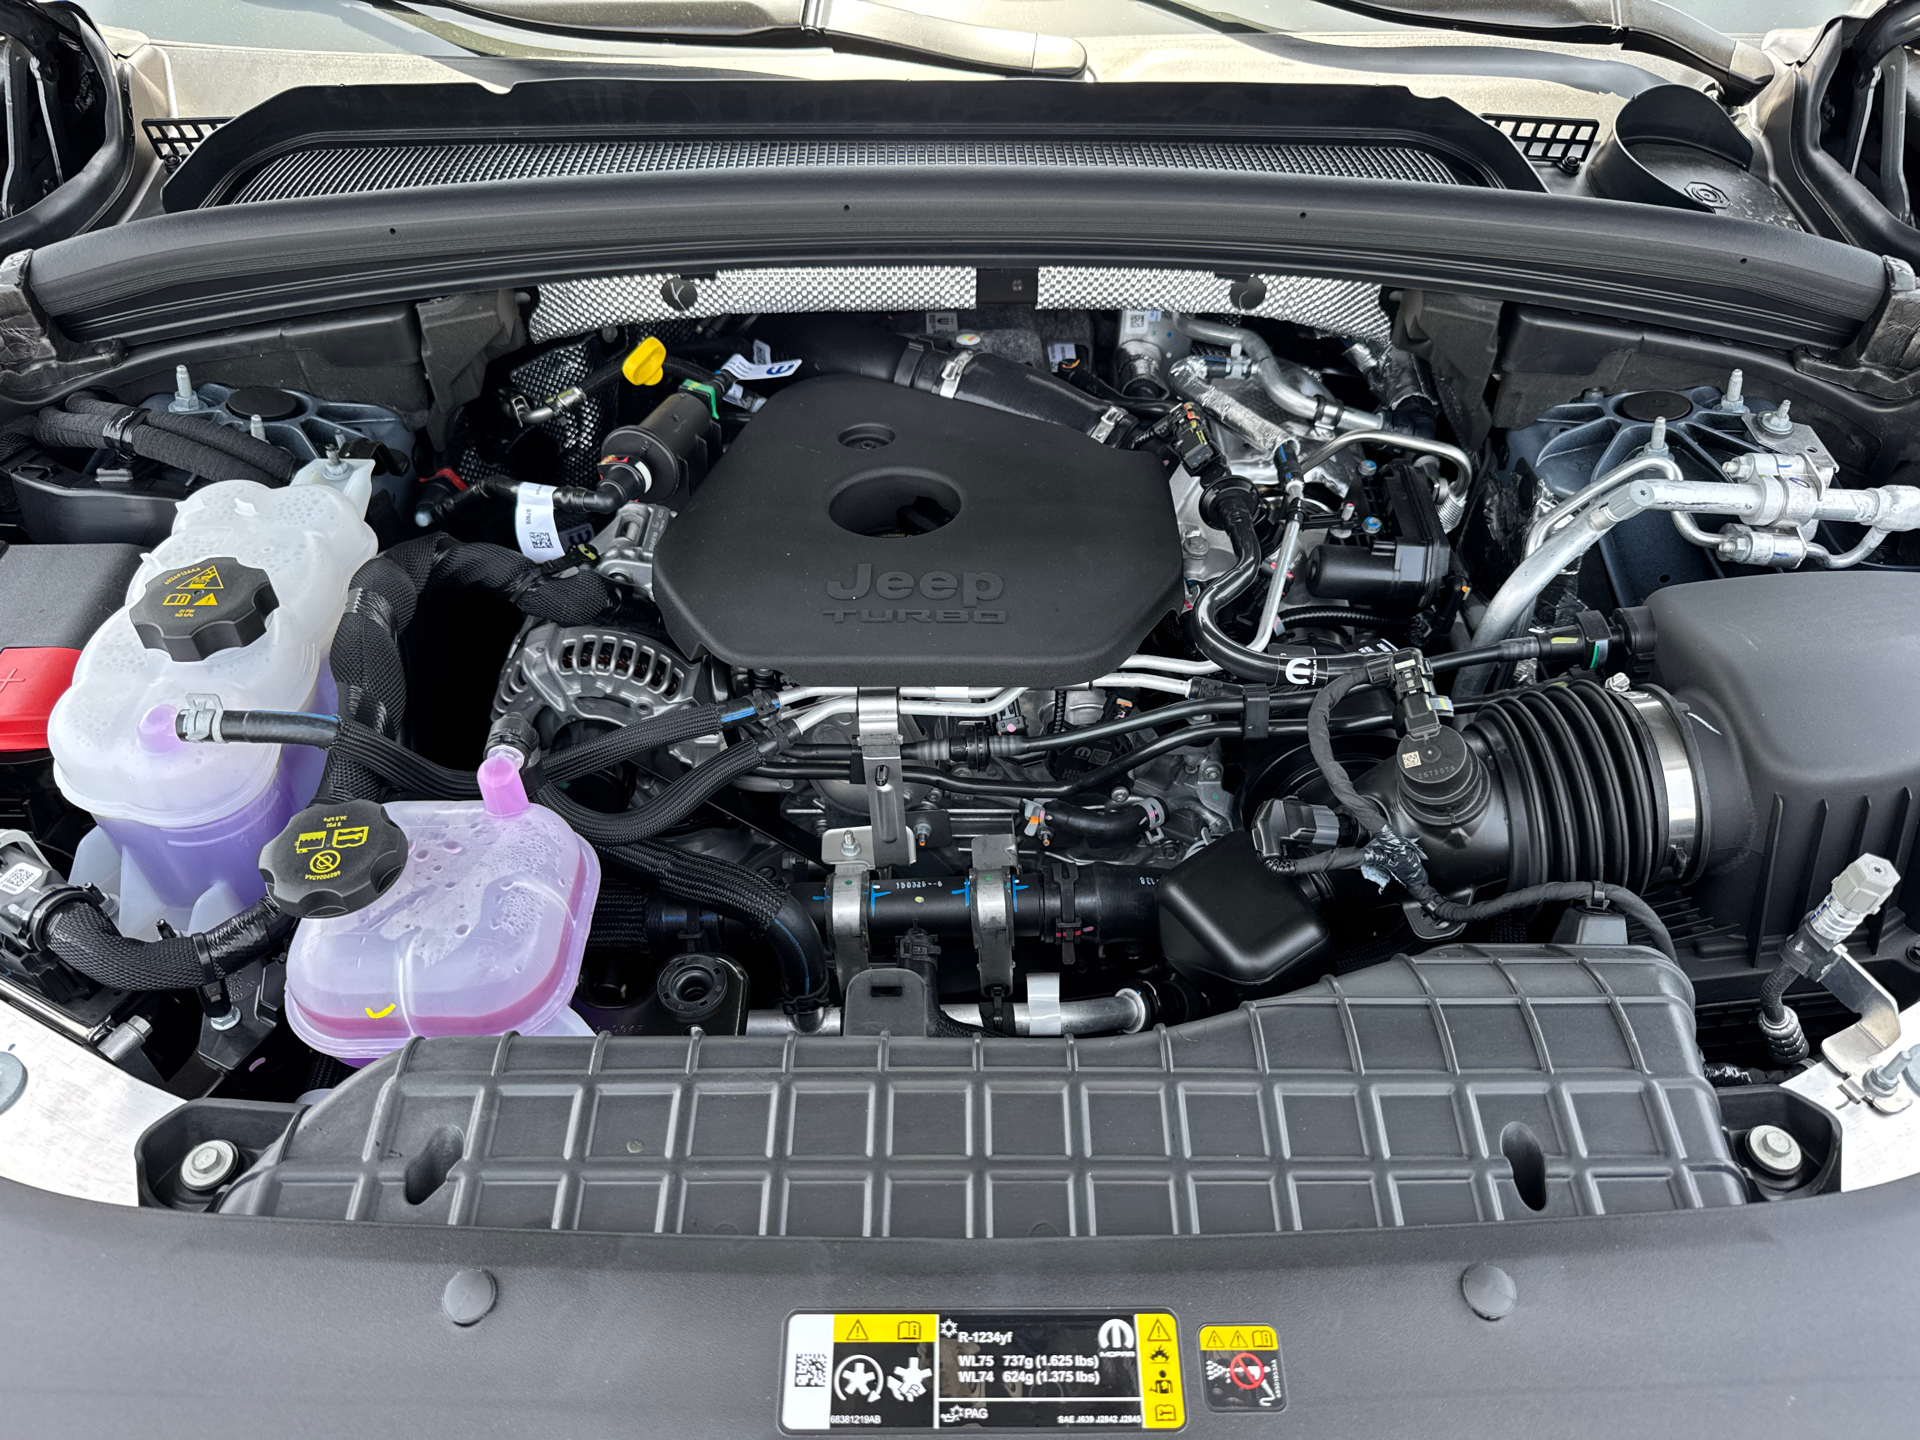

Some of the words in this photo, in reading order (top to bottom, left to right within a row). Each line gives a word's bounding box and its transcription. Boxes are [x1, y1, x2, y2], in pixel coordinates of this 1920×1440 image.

[827, 563, 1003, 608] Jeep
[822, 609, 1006, 624] TURBO
[958, 1331, 1013, 1346] R-1234yf
[1099, 1350, 1136, 1358] MOPAR
[957, 1355, 995, 1367] WL75
[1002, 1355, 1034, 1370] 737g
[1035, 1354, 1073, 1369] (1.625
[1074, 1354, 1100, 1369] lbs)
[957, 1370, 995, 1383] WL74
[1002, 1370, 1035, 1385] 624g
[1036, 1370, 1074, 1385] (1.375
[1075, 1370, 1101, 1385] lbs)
[829, 1414, 882, 1424] 68381219AB
[964, 1407, 989, 1420] PAG
[1057, 1415, 1075, 1424] SAE
